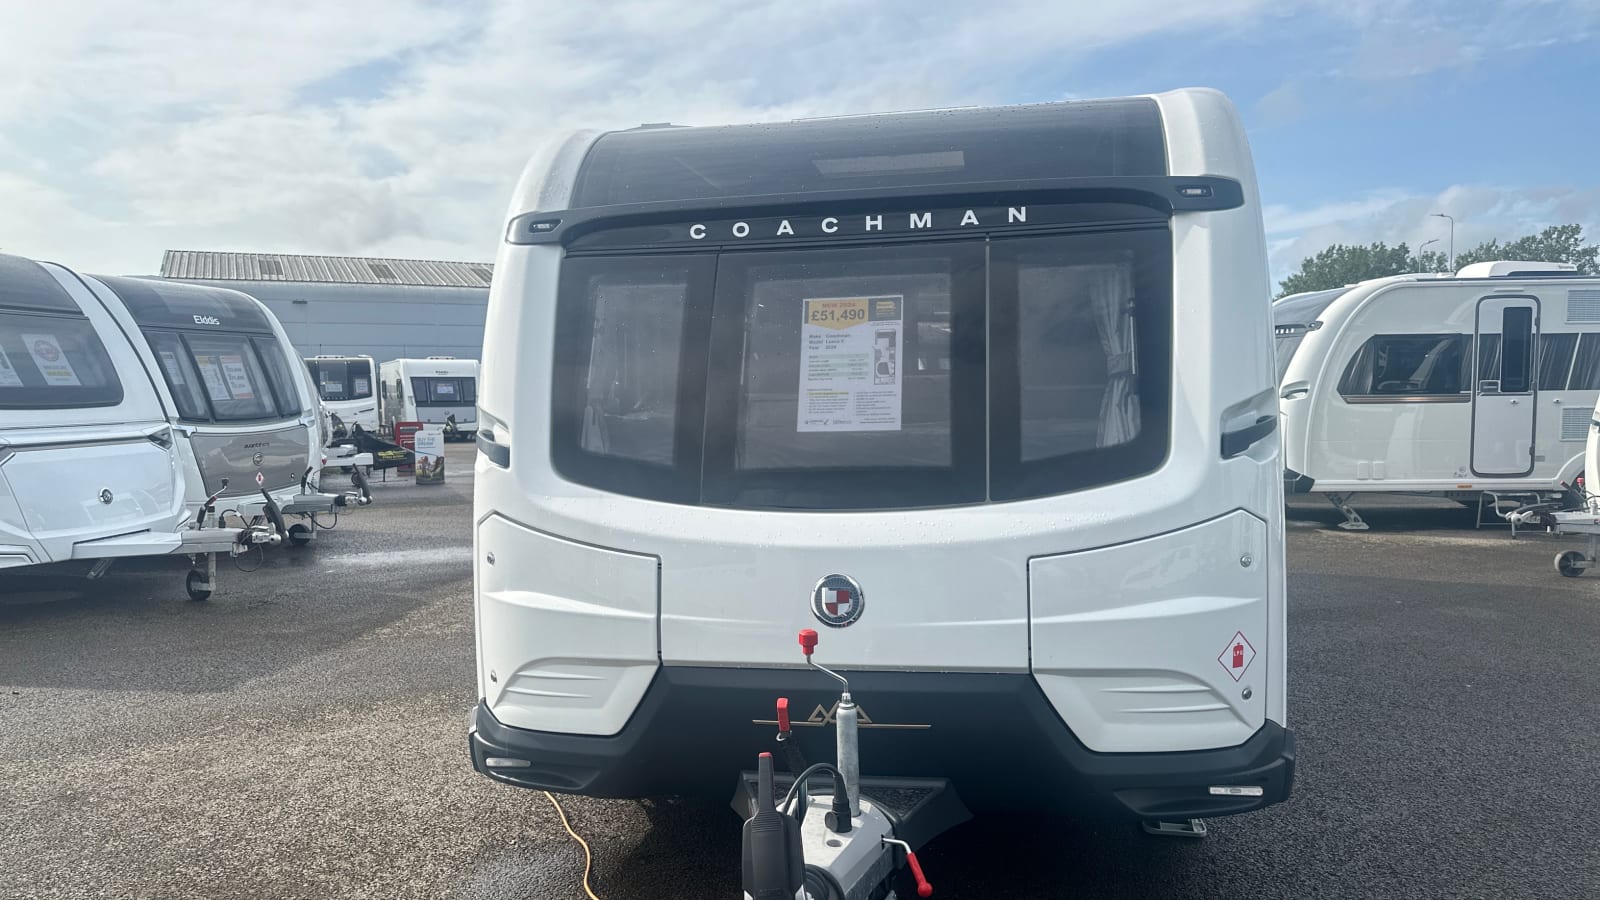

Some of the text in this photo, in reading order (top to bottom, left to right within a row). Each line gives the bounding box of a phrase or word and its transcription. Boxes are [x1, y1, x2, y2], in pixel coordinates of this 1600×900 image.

[689, 206, 1027, 239] COACHMAN
[193, 314, 220, 326] Elddis
[811, 308, 865, 322] £51,490
